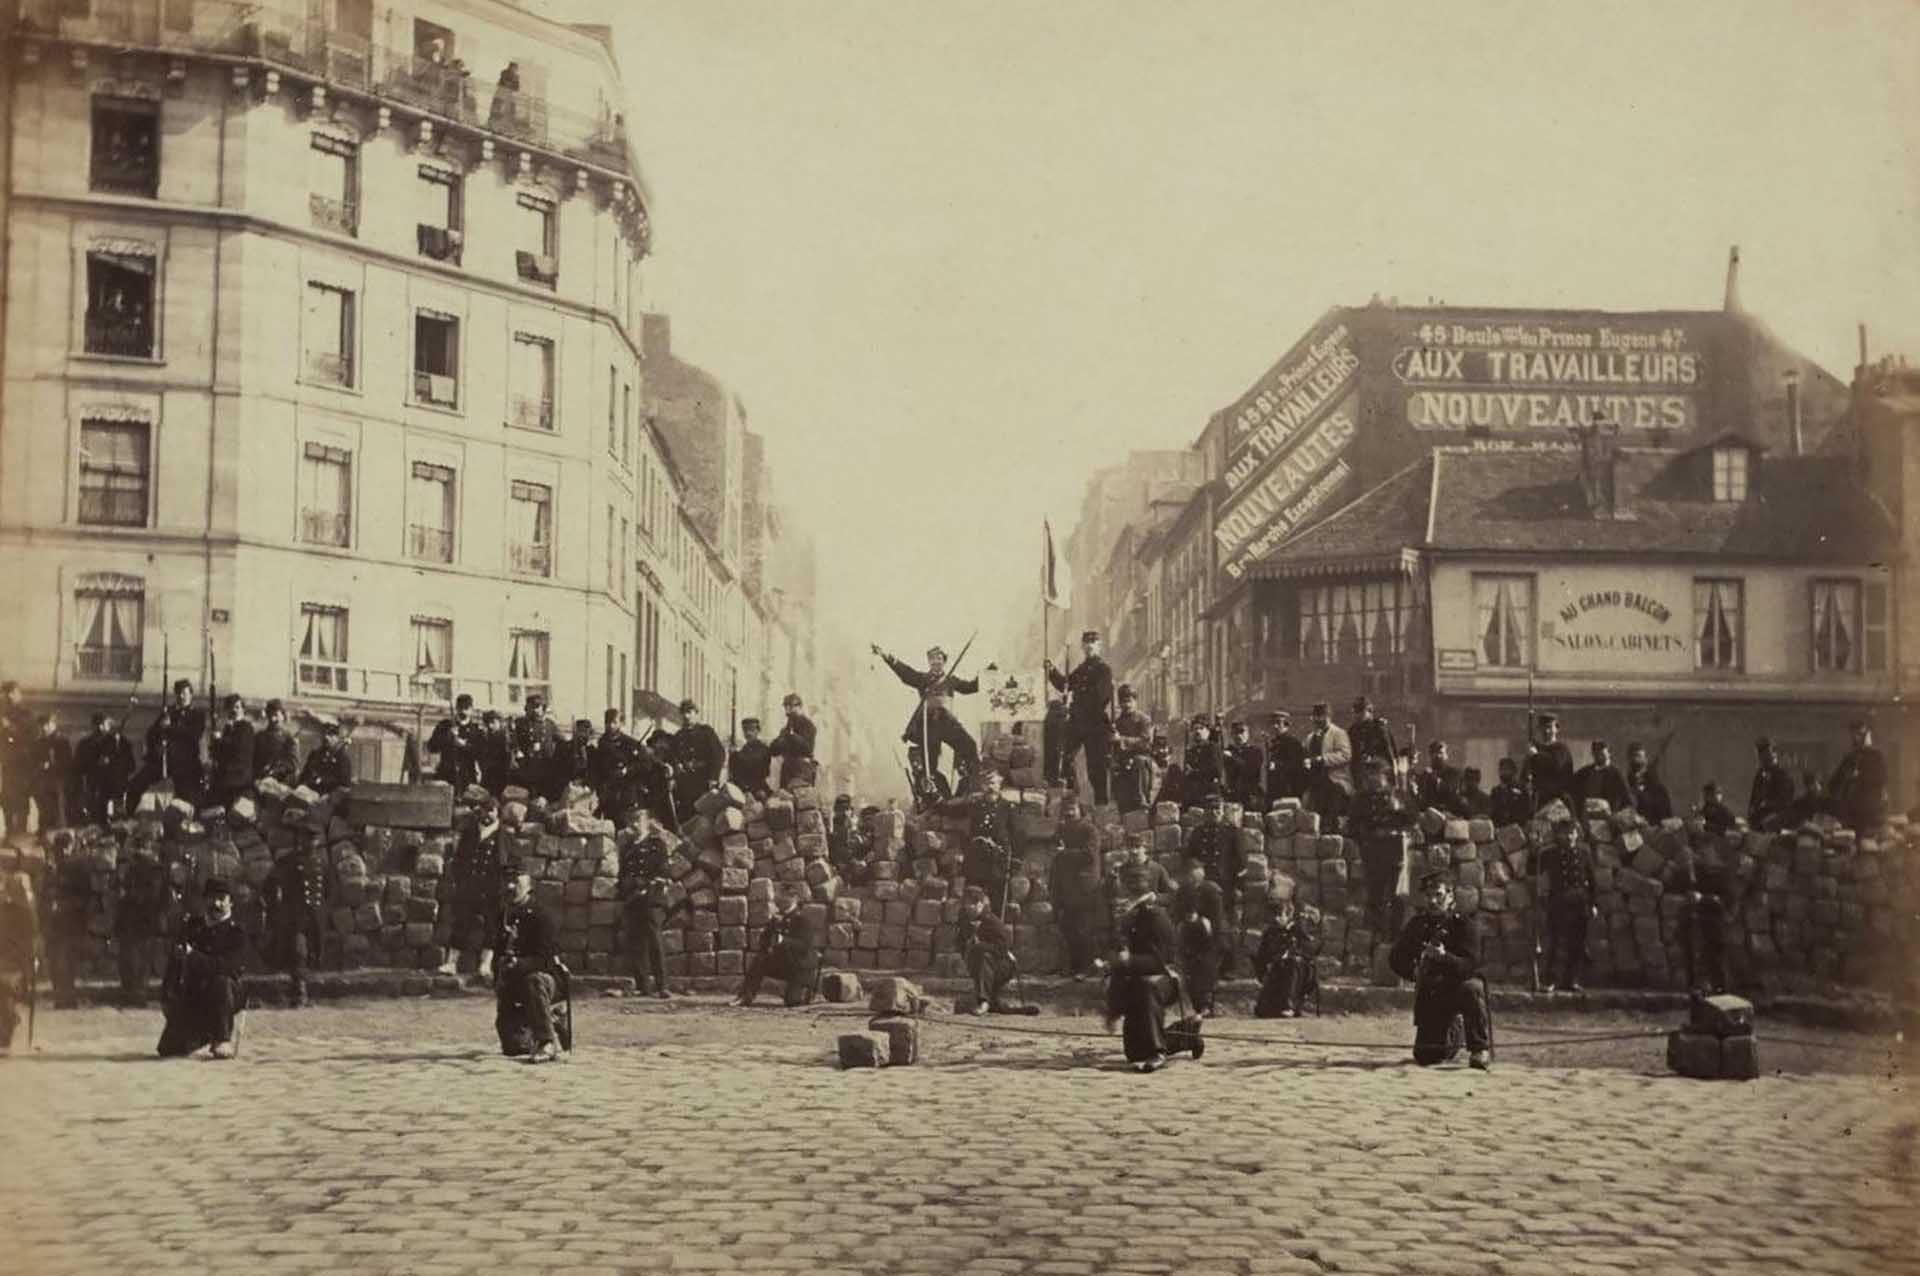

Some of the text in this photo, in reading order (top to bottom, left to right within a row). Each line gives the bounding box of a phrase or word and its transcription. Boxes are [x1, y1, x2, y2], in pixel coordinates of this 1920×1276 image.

[1538, 327, 1593, 347] Prince
[1408, 350, 1697, 384] AUX TRAVAILLEURS
[1249, 347, 1360, 457] TRAVAILLEURS
[1560, 590, 1672, 624] AU GRAND BALCON
